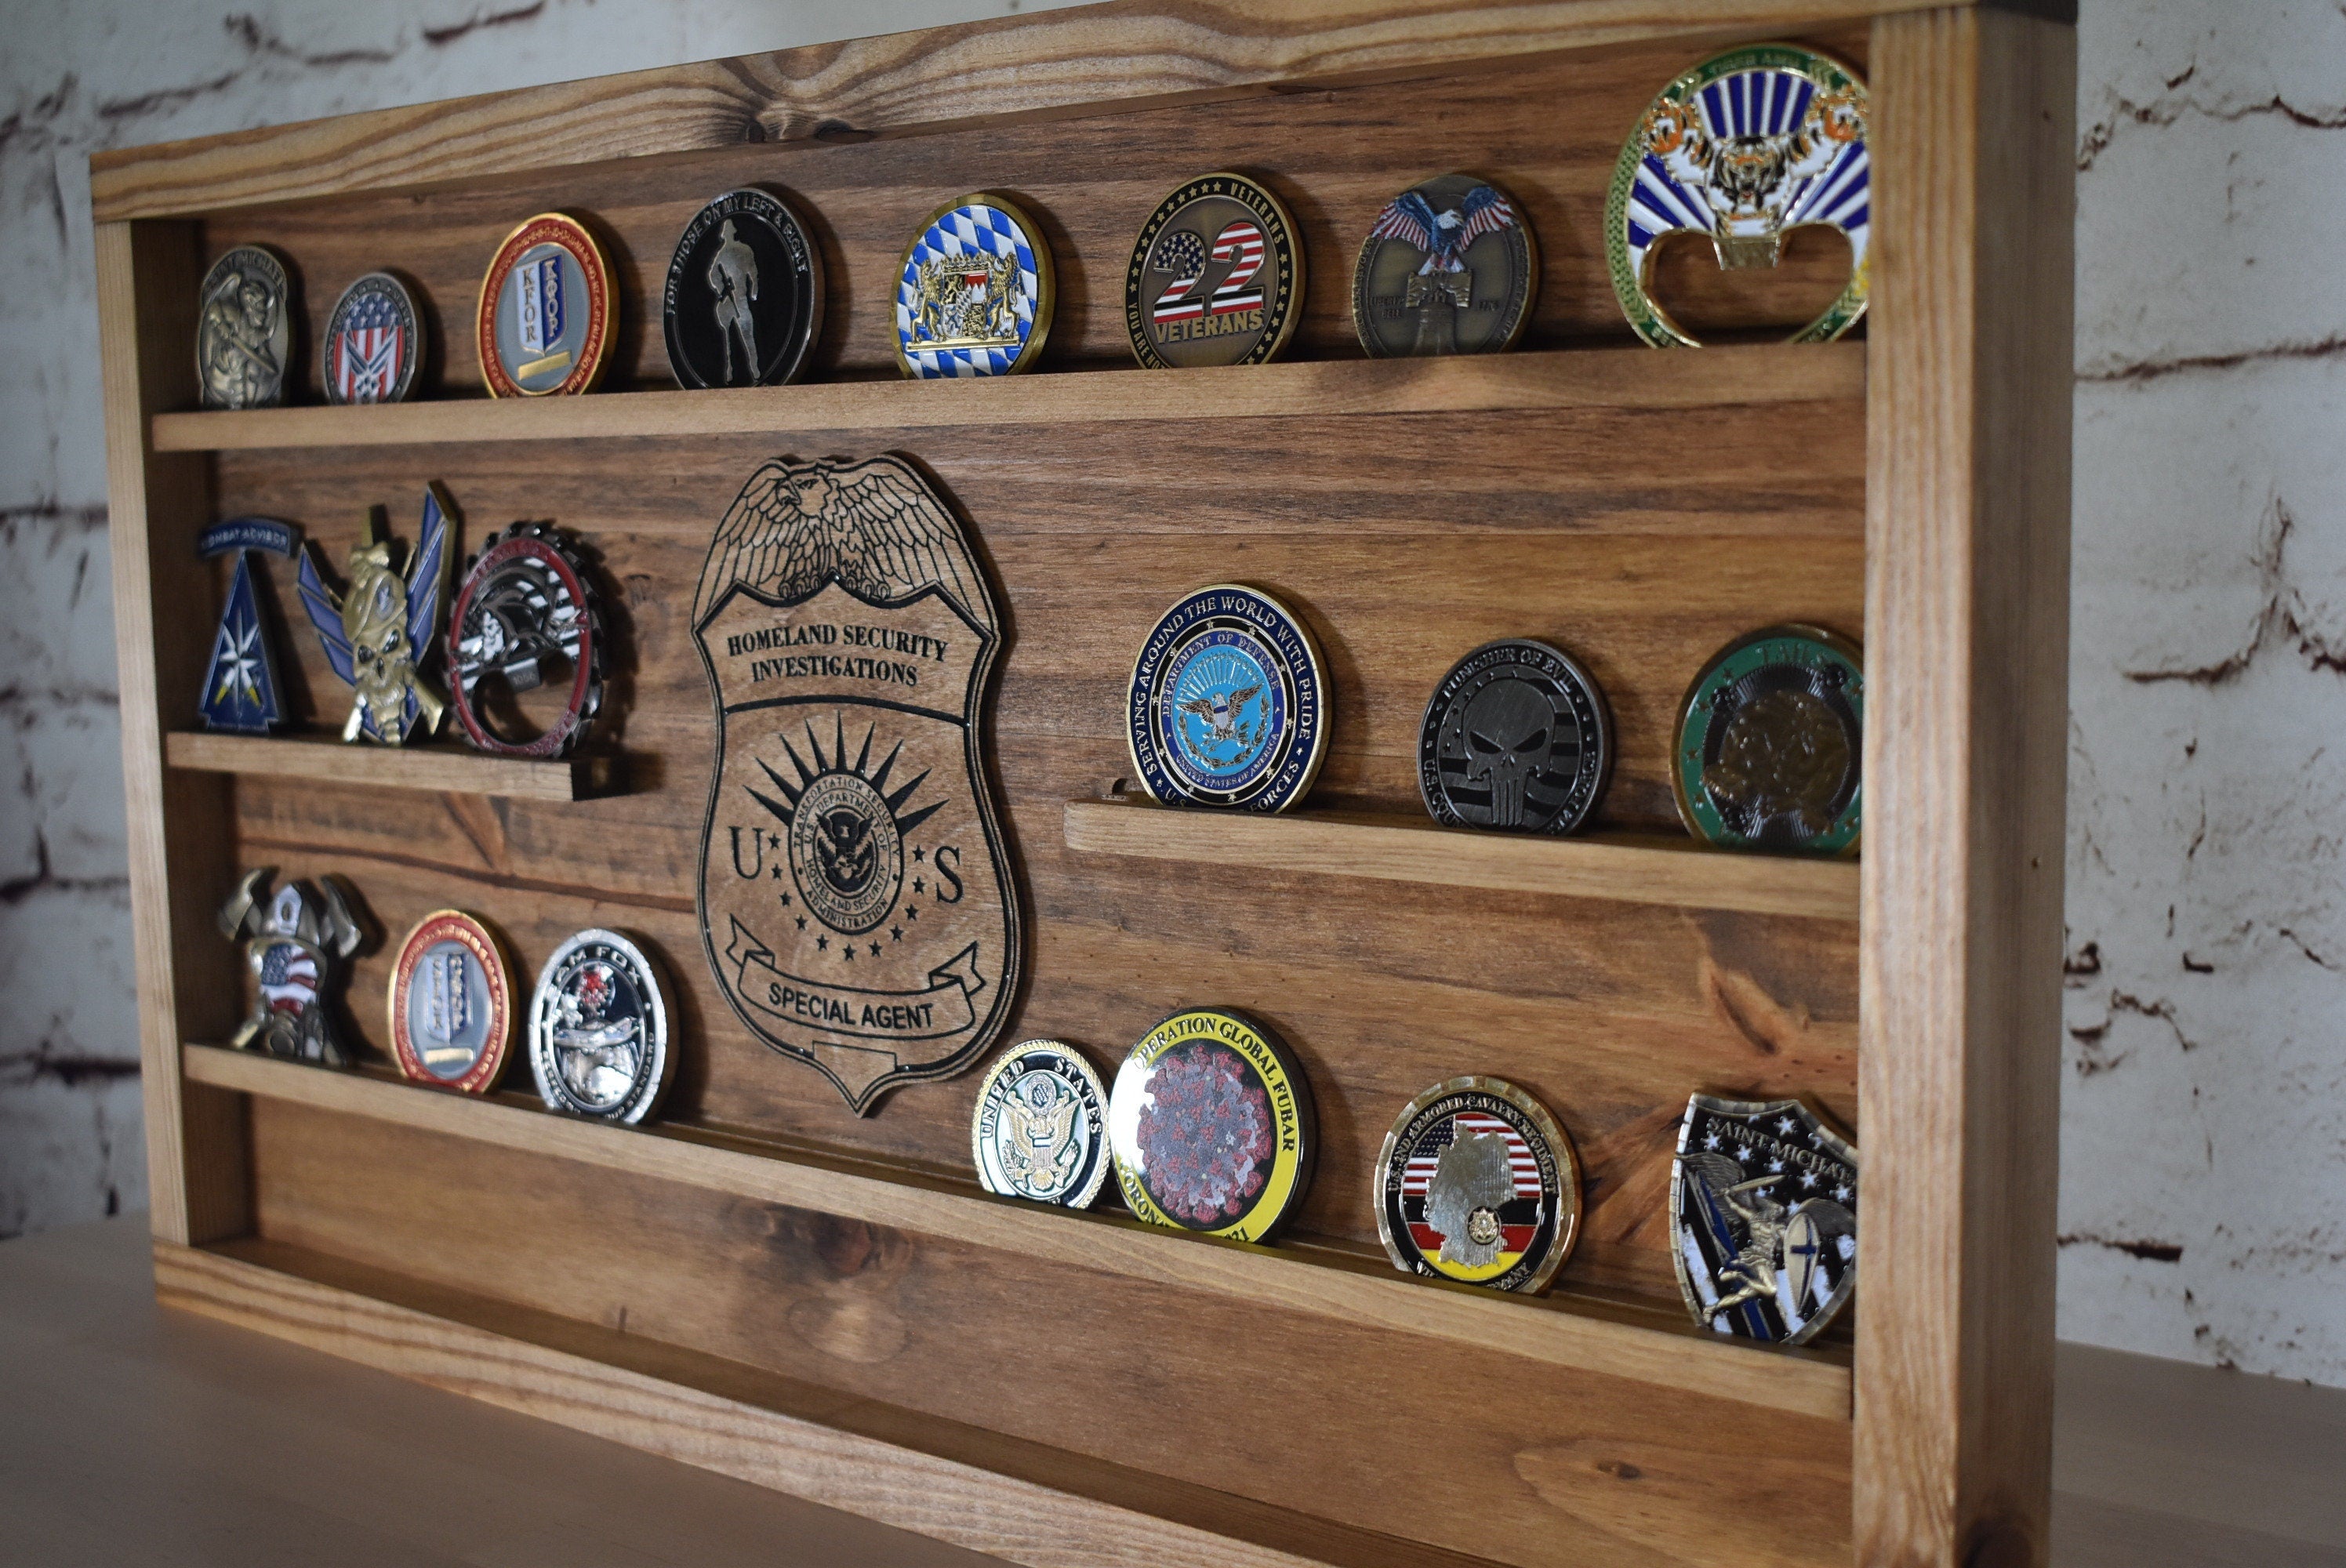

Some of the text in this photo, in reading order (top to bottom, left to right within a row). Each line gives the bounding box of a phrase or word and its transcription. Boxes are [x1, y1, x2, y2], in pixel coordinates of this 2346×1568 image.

[1230, 182, 1284, 245] VETERANS
[666, 196, 808, 315] FOR THOSE ON MY LEFT & RIGHT
[1153, 222, 1266, 325] 22
[522, 267, 538, 343] KFOR
[1128, 302, 1141, 330] YOU
[1153, 310, 1265, 344] VETERANS
[1133, 332, 1149, 355] ARE
[727, 624, 949, 662] HOMELAND SECURITY
[750, 655, 918, 687] INVESTIGATIONS
[1135, 596, 1313, 775] SERVING AROUND THE WORLD WITH PRIDE
[1161, 633, 1282, 717] DEPARTMENT OF DEFENSE
[1442, 648, 1574, 699] PUNISHER OF EVIL
[1175, 753, 1204, 786] UNITED
[1250, 732, 1280, 778] AMERICA
[1249, 760, 1300, 812] FORCES
[794, 775, 900, 857] TRANSPORTATION SECURITY
[815, 792, 881, 829] DEPARTMENT
[877, 833, 888, 851] OF
[728, 826, 767, 880] U
[935, 844, 964, 904] S
[805, 858, 887, 911] HOMELAND SECURITY
[805, 891, 889, 928] ADMINISTRATION
[594, 946, 641, 985] FOX
[768, 982, 934, 1030] SPECIAL AGENT
[626, 1031, 655, 1107] STANDARD
[980, 1055, 1103, 1139] UNITED STATES
[1133, 1018, 1298, 1152] OPERATION GLOBAL FUBAR
[1396, 1136, 1413, 1165] 2ND
[1409, 1096, 1464, 1141] ARMORED
[1466, 1095, 1520, 1127] CAVALRY
[1520, 1123, 1559, 1196] REGIMENT
[1707, 1117, 1857, 1180] SAINT MICHA
